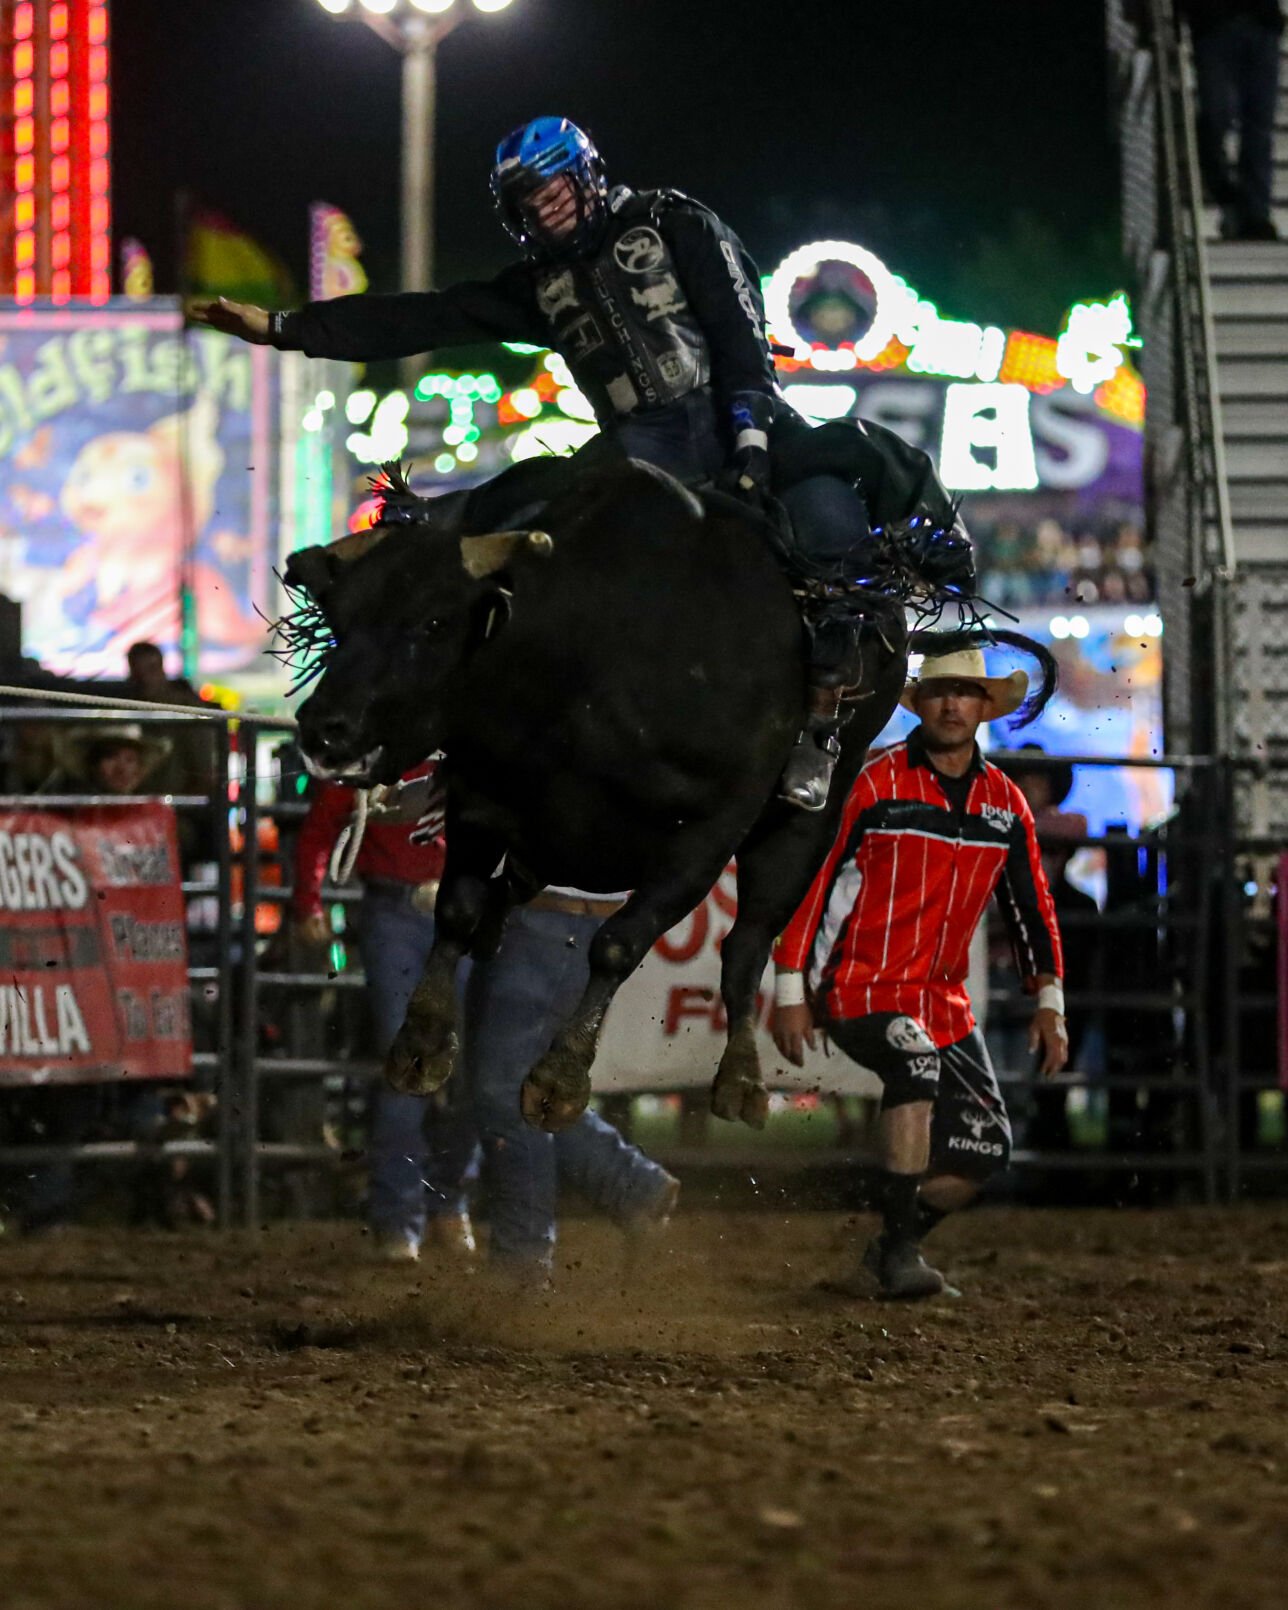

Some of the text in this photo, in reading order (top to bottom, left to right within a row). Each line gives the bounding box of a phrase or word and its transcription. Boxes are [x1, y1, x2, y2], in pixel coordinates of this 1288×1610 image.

[592, 266, 657, 402] HUTCHINGS
[720, 240, 764, 340] CINCH
[0, 830, 88, 910] GERS
[948, 1136, 1004, 1157] KINGS
